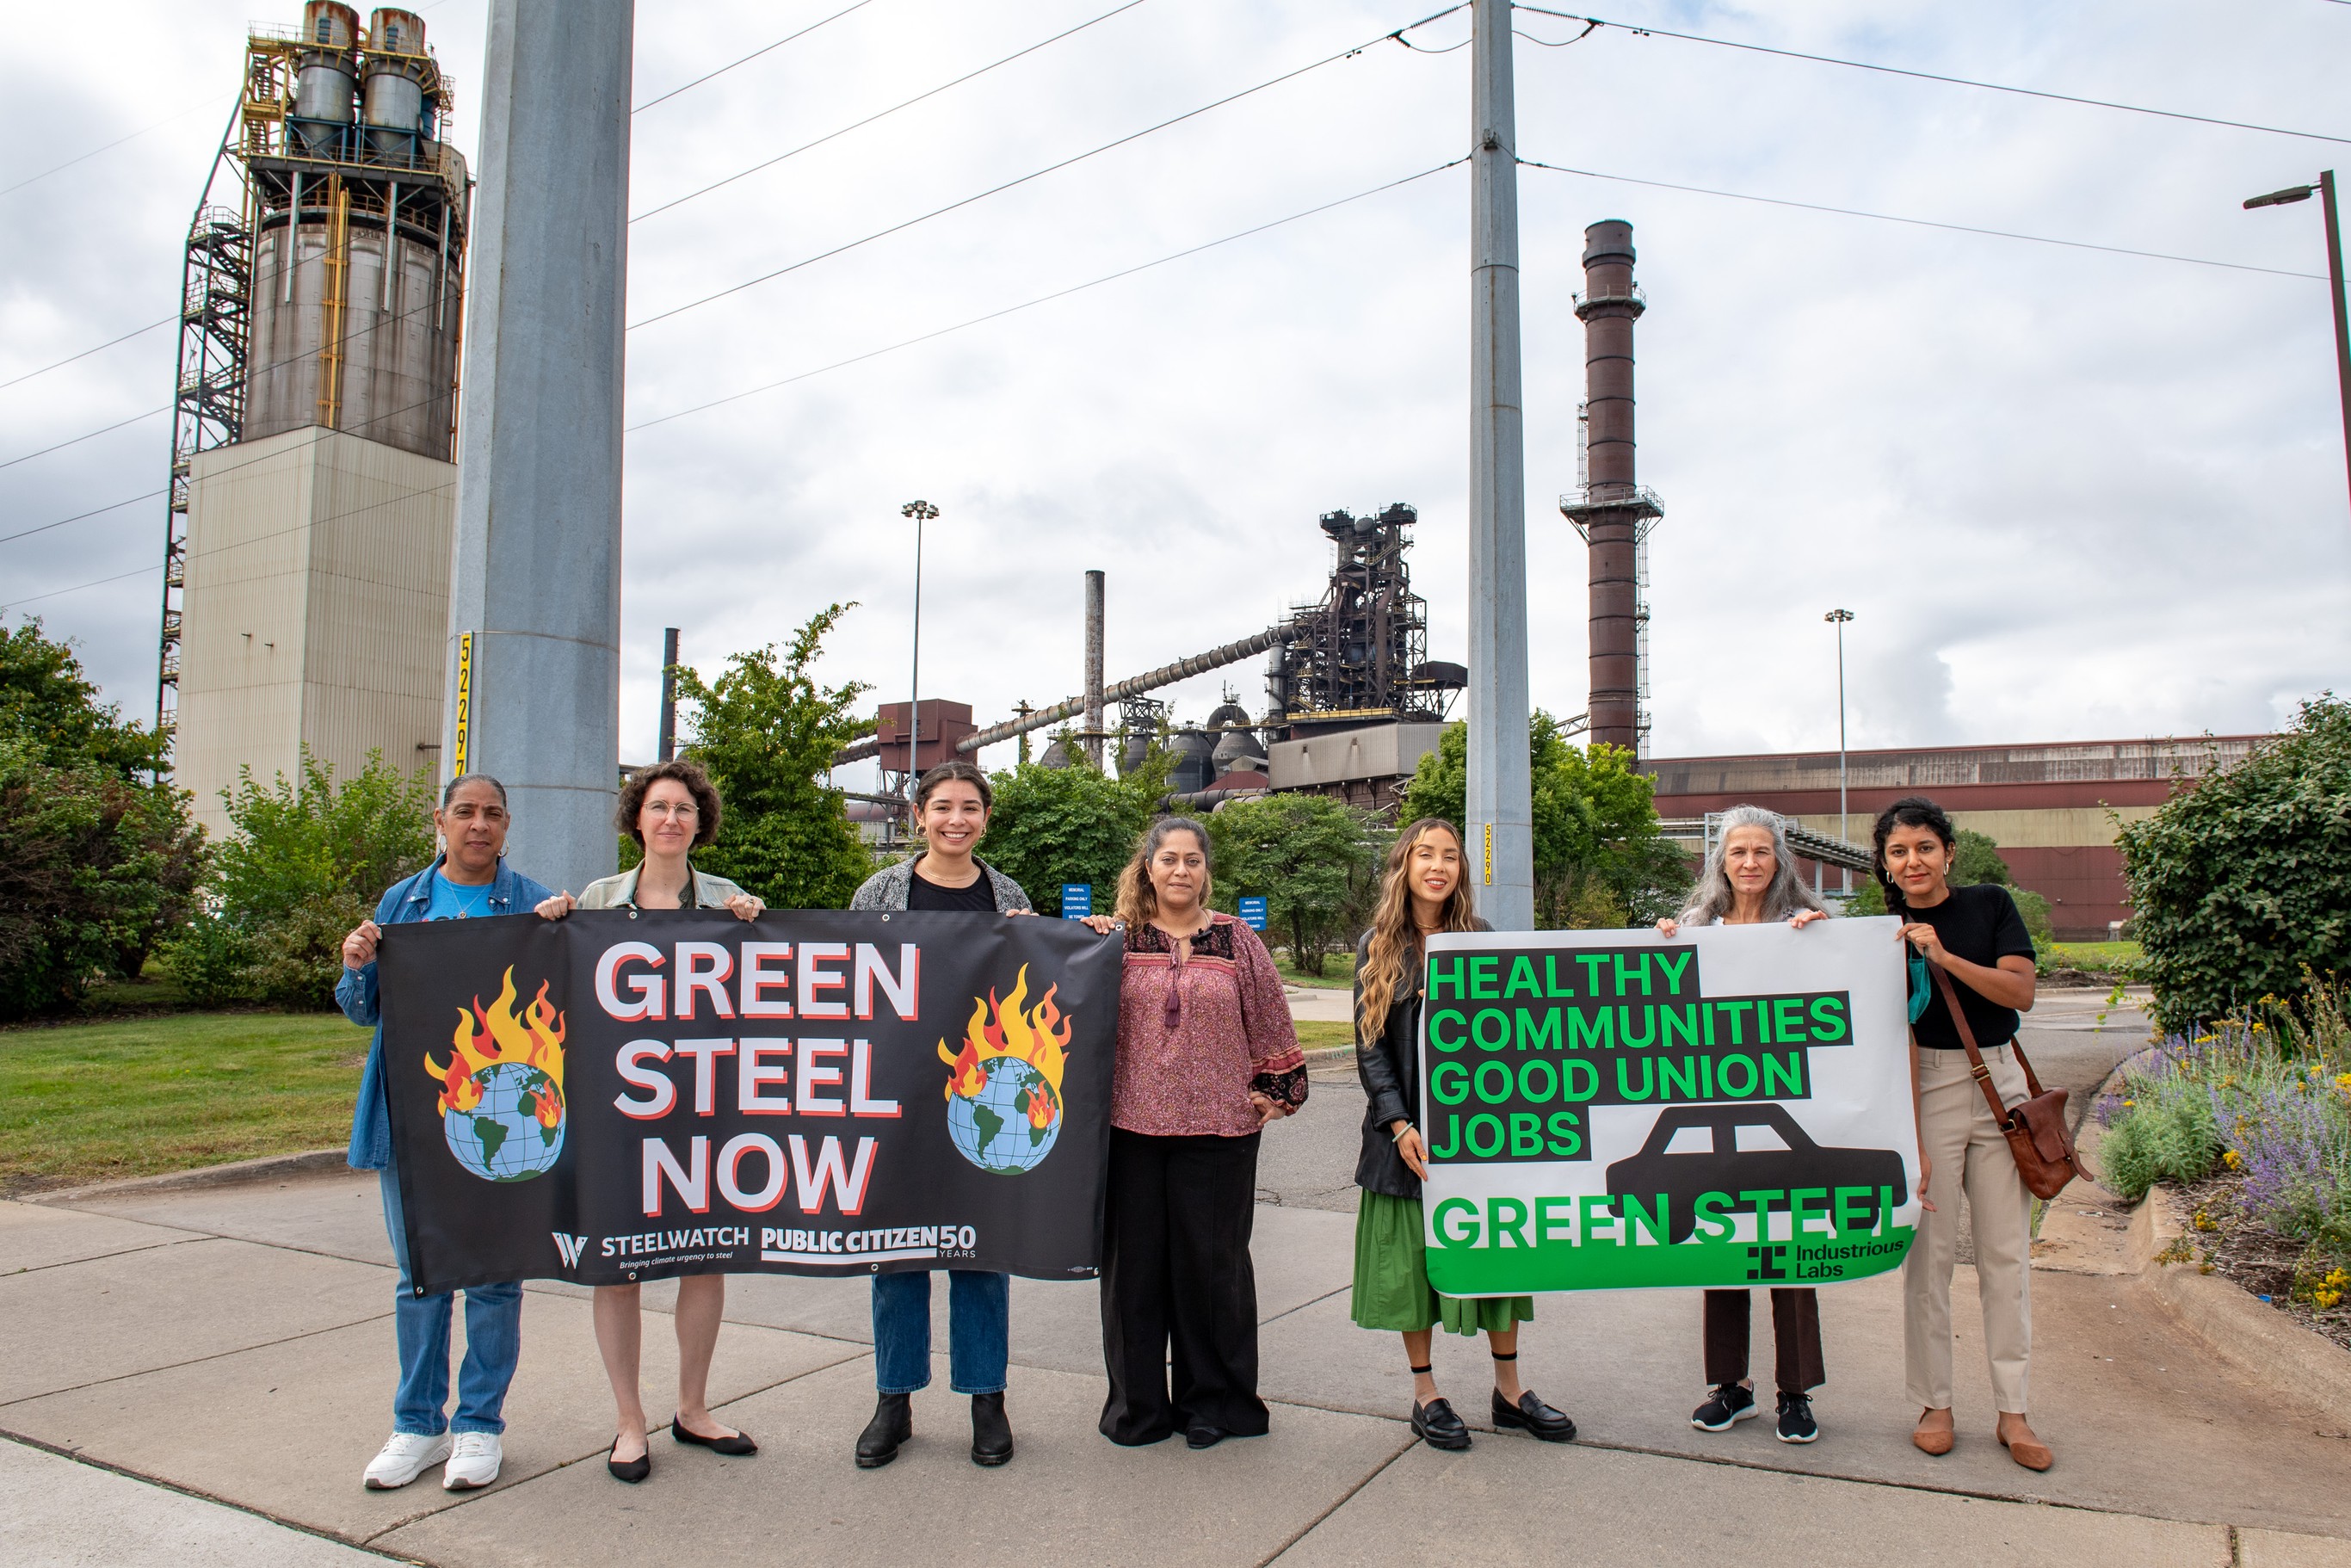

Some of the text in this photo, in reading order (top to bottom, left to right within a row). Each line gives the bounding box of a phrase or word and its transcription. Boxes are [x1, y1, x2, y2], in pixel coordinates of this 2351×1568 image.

[595, 941, 920, 1022] GREEN
[1428, 952, 1692, 1000] HEALTHY
[1429, 997, 1847, 1053] COMMUNITIES
[613, 1037, 903, 1120] STEEL
[1430, 1052, 1803, 1105] GOOD UNION
[1431, 1111, 1582, 1158] JOBS
[642, 1134, 879, 1218] NOW
[762, 1225, 977, 1253] PUBLIC CITIZEN 50
[1432, 1185, 1913, 1249] GREEN STEEL
[601, 1226, 750, 1256] STEELWATCH
[619, 1258, 650, 1269] Bringing
[651, 1256, 676, 1266] climate
[676, 1253, 706, 1263] urgency
[939, 1250, 977, 1259] YEARS
[1796, 1240, 1904, 1262] Industrious
[1796, 1262, 1843, 1279] Labs
